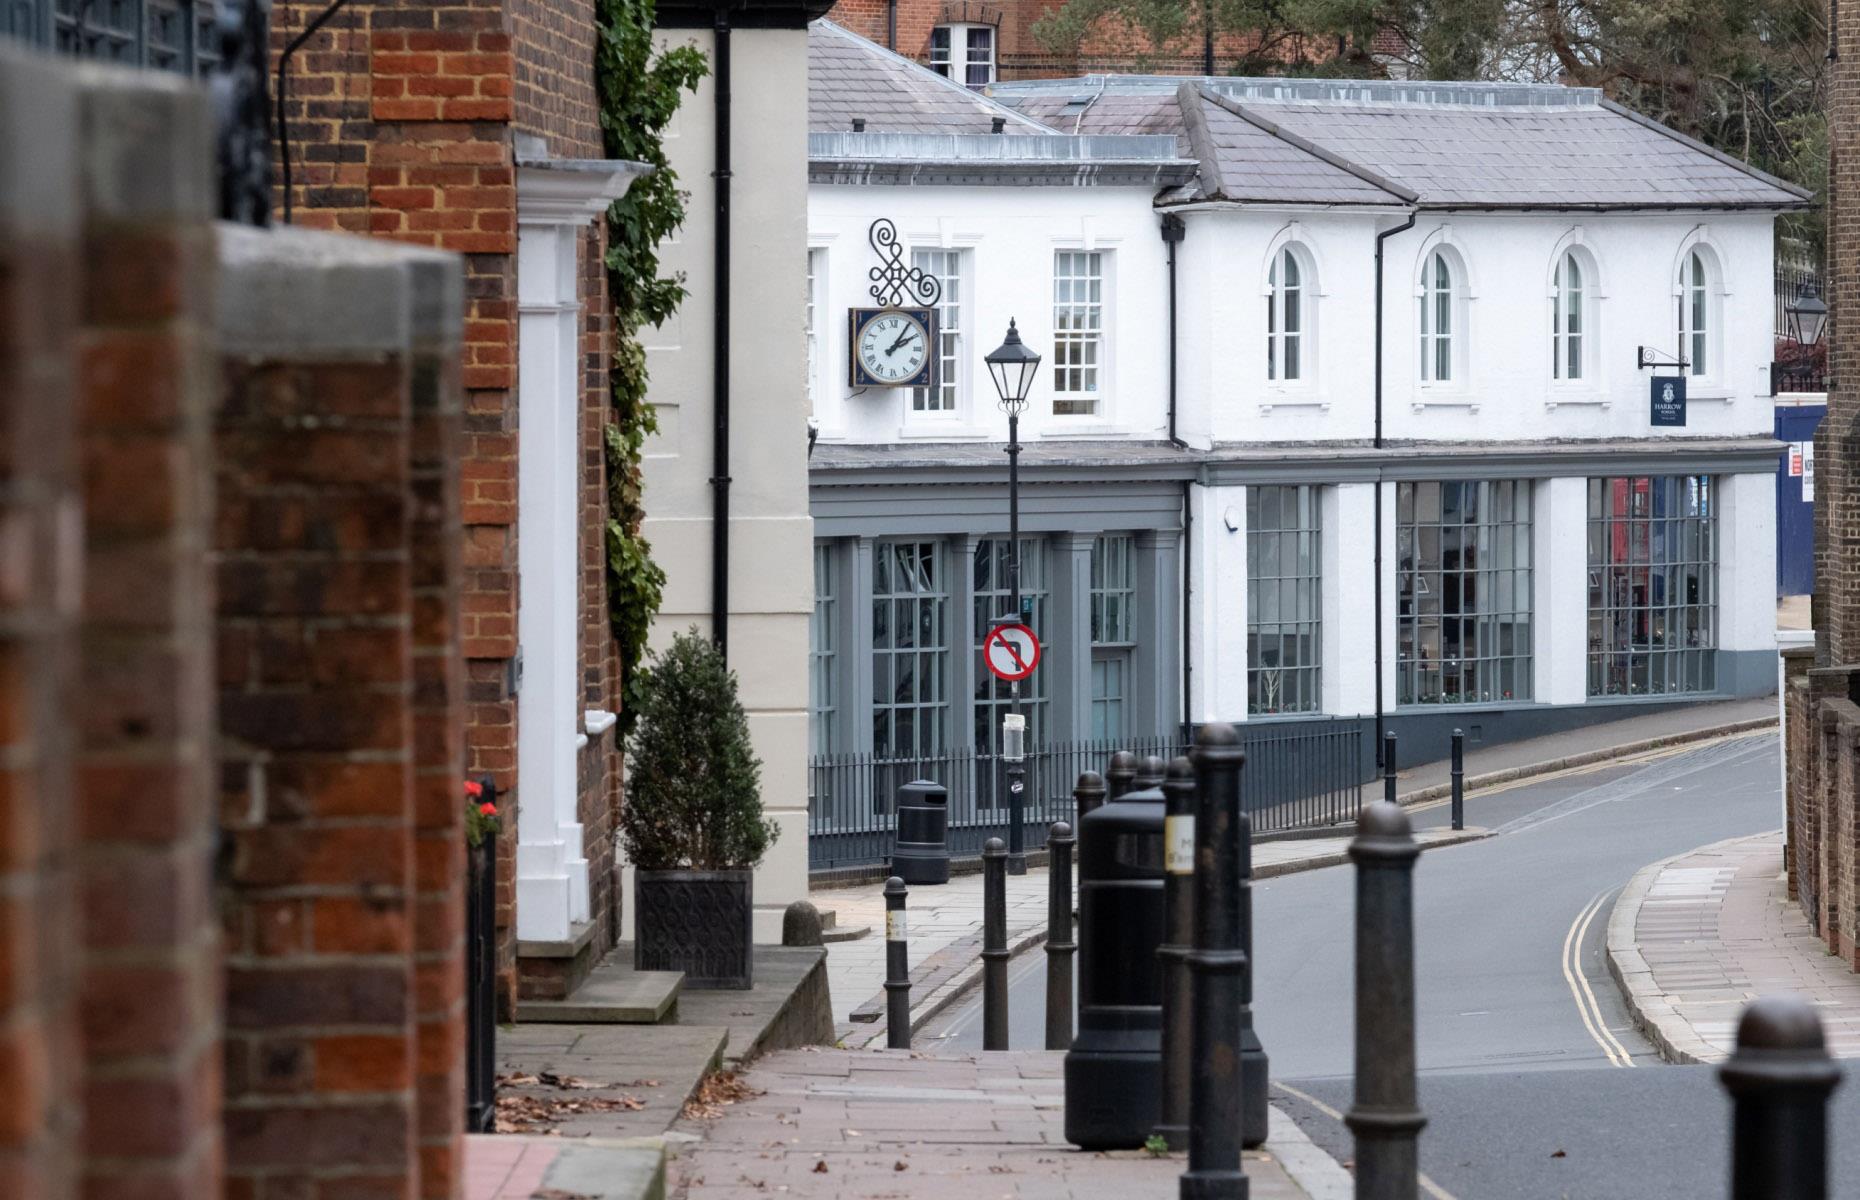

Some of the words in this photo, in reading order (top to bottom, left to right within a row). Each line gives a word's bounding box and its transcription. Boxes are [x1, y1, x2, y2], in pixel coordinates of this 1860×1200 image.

[920, 312, 928, 323] 9
[889, 319, 898, 328] XII
[920, 373, 928, 383] 2
